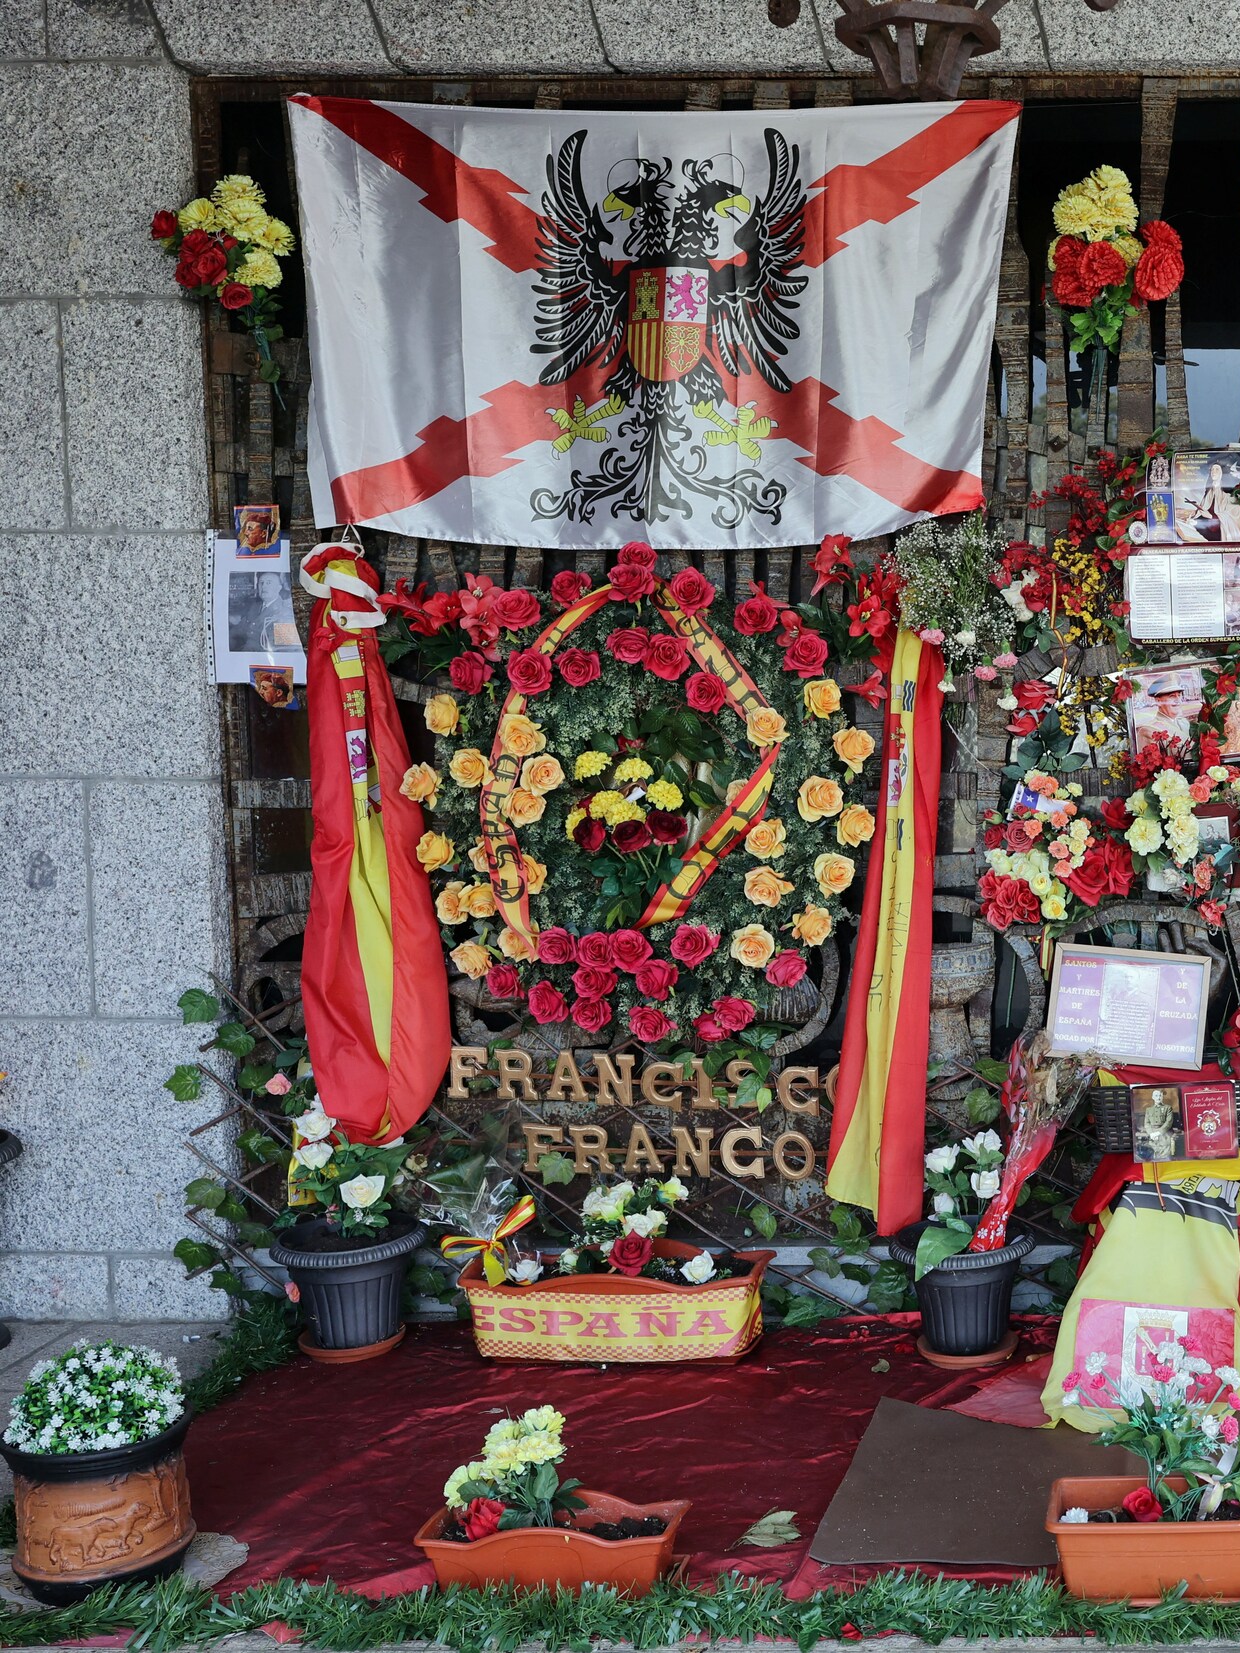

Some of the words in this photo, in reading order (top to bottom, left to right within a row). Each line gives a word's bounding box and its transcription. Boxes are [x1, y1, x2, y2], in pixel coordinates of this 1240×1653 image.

[1064, 959, 1097, 969] SANTOS
[1176, 982, 1188, 990] DE
[1059, 986, 1101, 997] MARTIRES
[1175, 996, 1187, 1004] LA
[1071, 1002, 1083, 1010] DE
[1159, 1011, 1198, 1020] CRUZADA
[1058, 1016, 1093, 1027] ESPAÑA
[1054, 1033, 1080, 1043] ROGAD
[1081, 1034, 1095, 1044] POR
[1155, 1043, 1195, 1053] NOSOTROS
[522, 1122, 816, 1181] FRANCO
[471, 1305, 734, 1338] ESPAÑA
